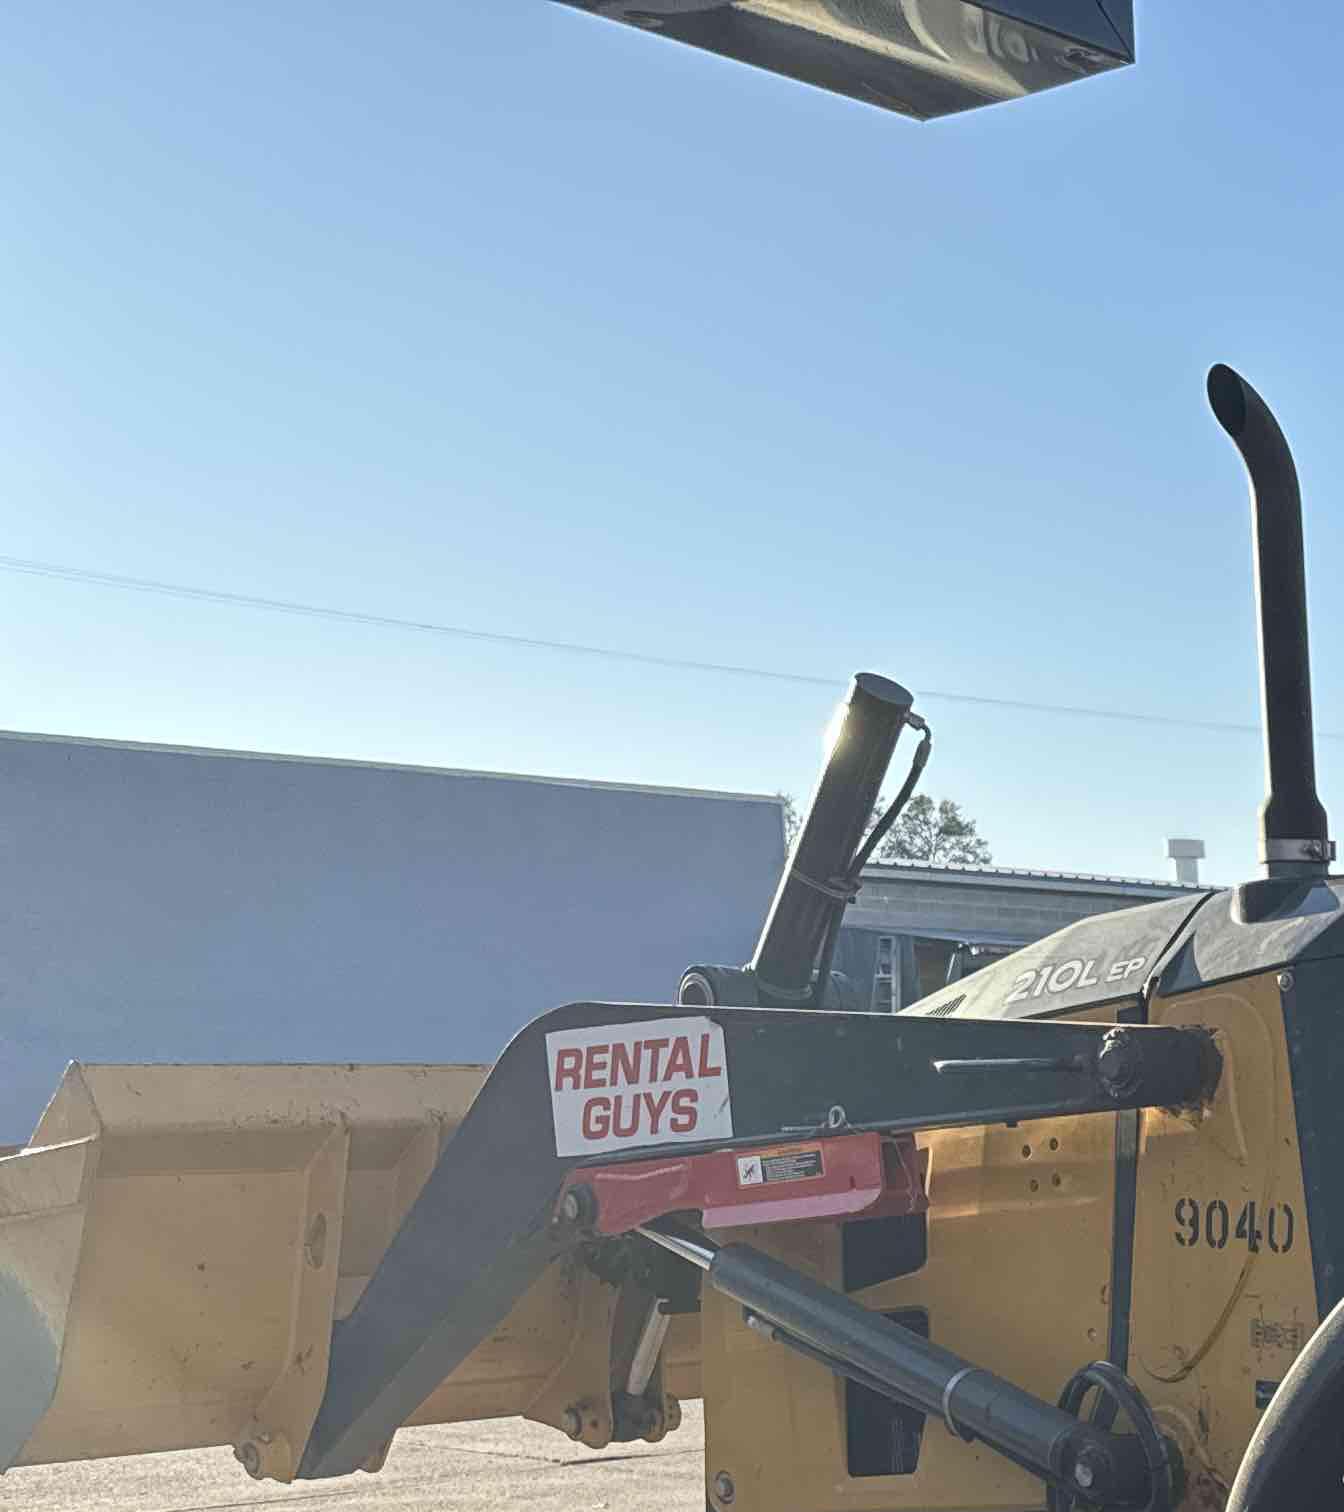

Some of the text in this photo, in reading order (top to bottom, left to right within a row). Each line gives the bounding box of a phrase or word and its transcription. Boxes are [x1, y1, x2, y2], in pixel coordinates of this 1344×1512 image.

[1004, 957, 1146, 1004] 210L EP
[555, 1033, 722, 1092] RENTAL
[582, 1088, 699, 1140] GUYS
[1174, 1197, 1294, 1253] 9040
